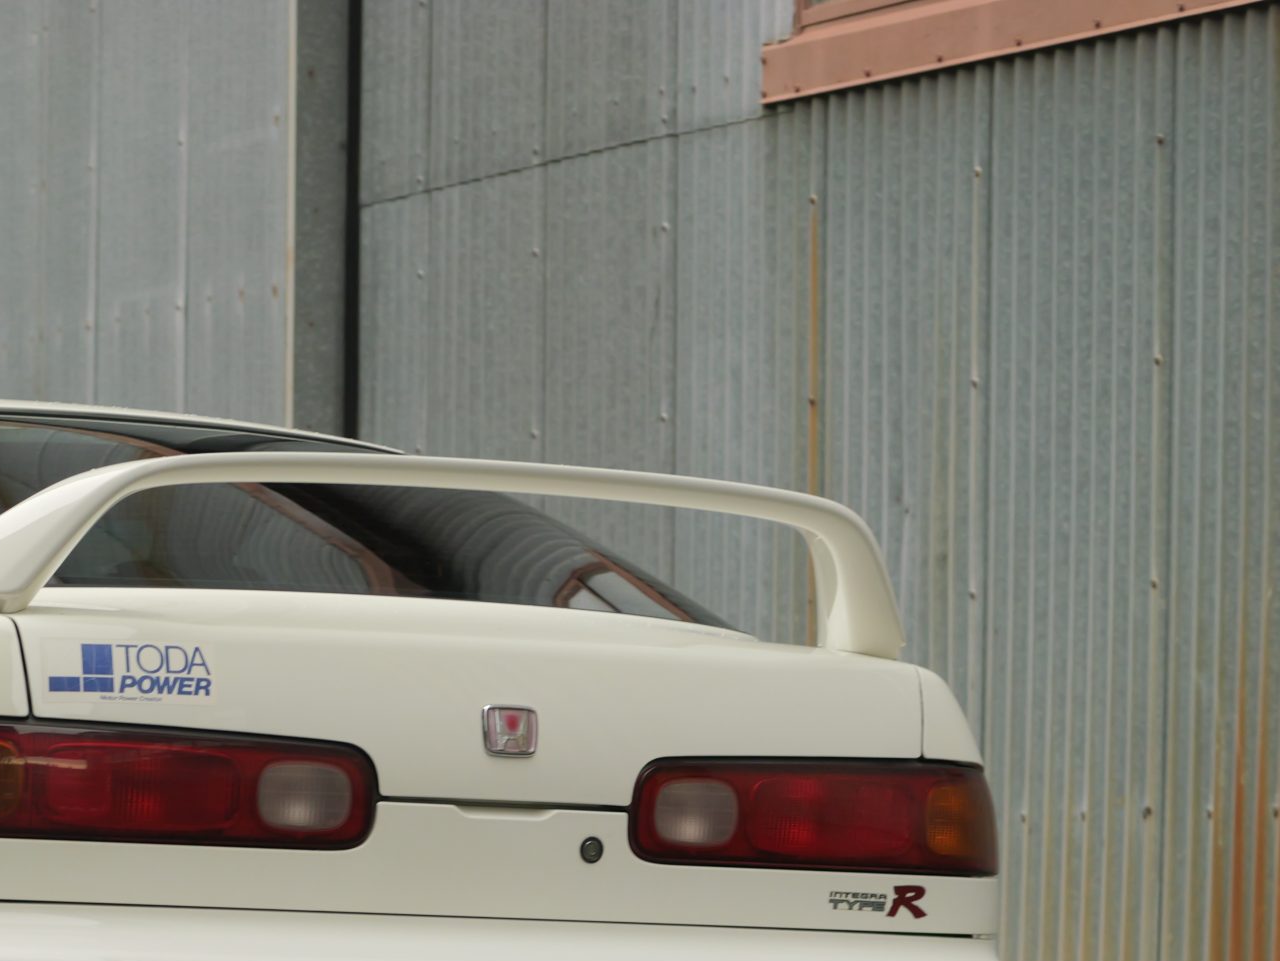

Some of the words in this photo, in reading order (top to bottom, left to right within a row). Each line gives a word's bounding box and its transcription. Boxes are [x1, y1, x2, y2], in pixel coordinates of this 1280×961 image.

[115, 643, 212, 676] TODA
[118, 674, 213, 697] POWER
[828, 890, 888, 900] INTEGRA
[828, 898, 887, 912] TYPE
[885, 884, 928, 919] R
